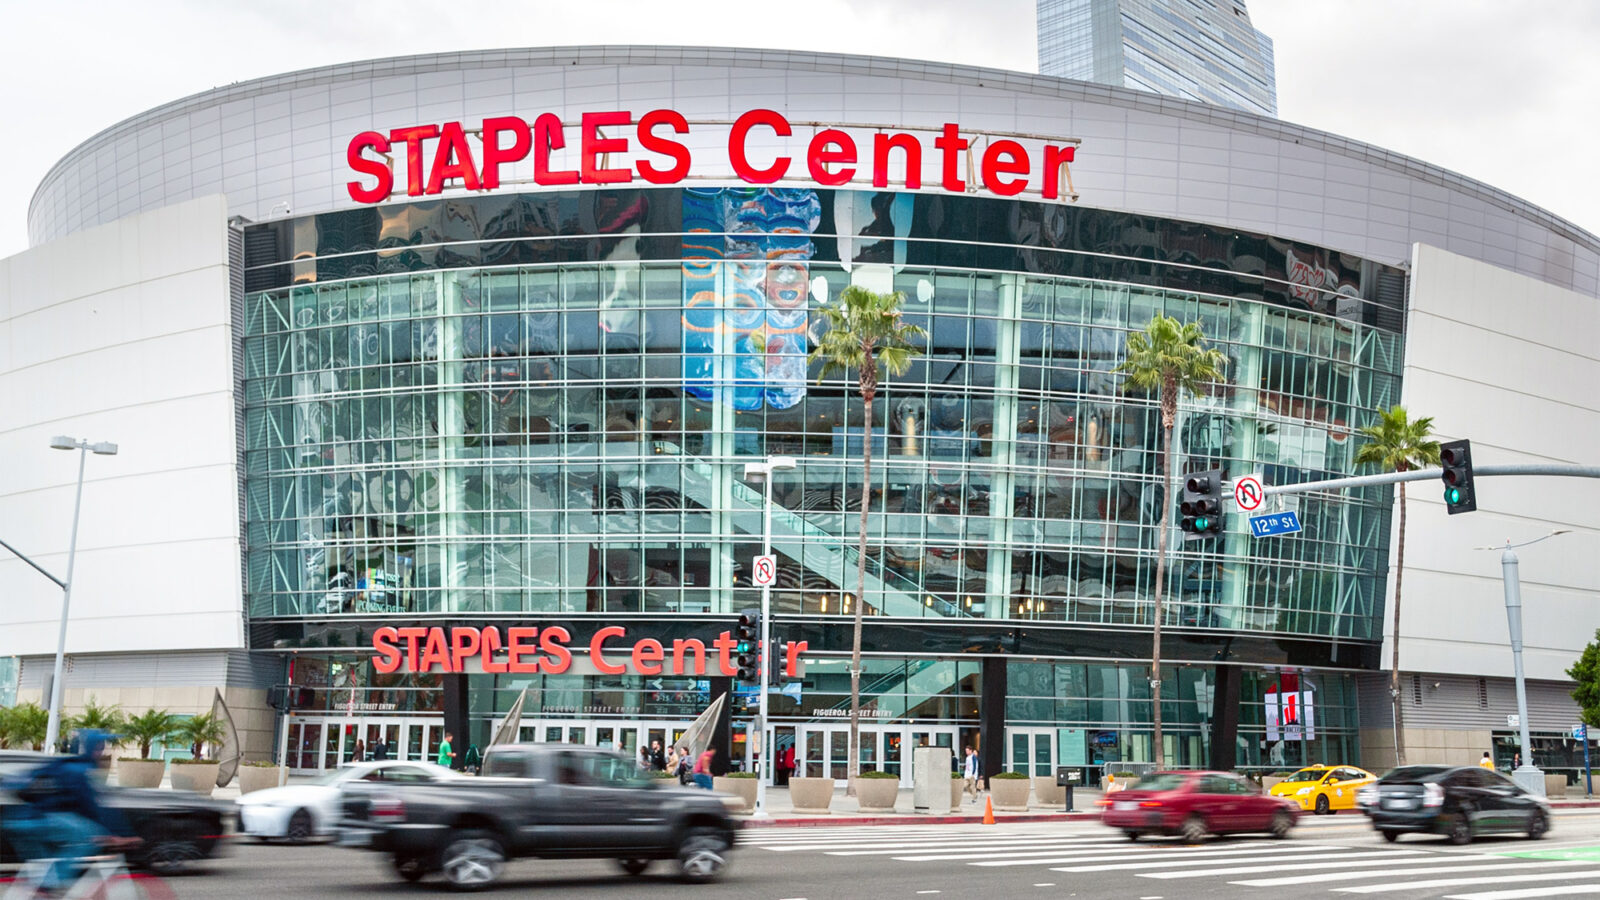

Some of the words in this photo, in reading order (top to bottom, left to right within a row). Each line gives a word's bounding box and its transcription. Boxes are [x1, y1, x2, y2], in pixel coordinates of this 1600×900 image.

[347, 109, 692, 203] STAPLES
[728, 109, 1076, 199] Center
[1254, 517, 1279, 533] 12th
[1281, 516, 1295, 528] St
[372, 626, 573, 674] STAPLES
[590, 627, 808, 677] Centr
[812, 708, 847, 717] FIGUEROA
[848, 709, 872, 717] SEET
[872, 709, 894, 718] ENTRY
